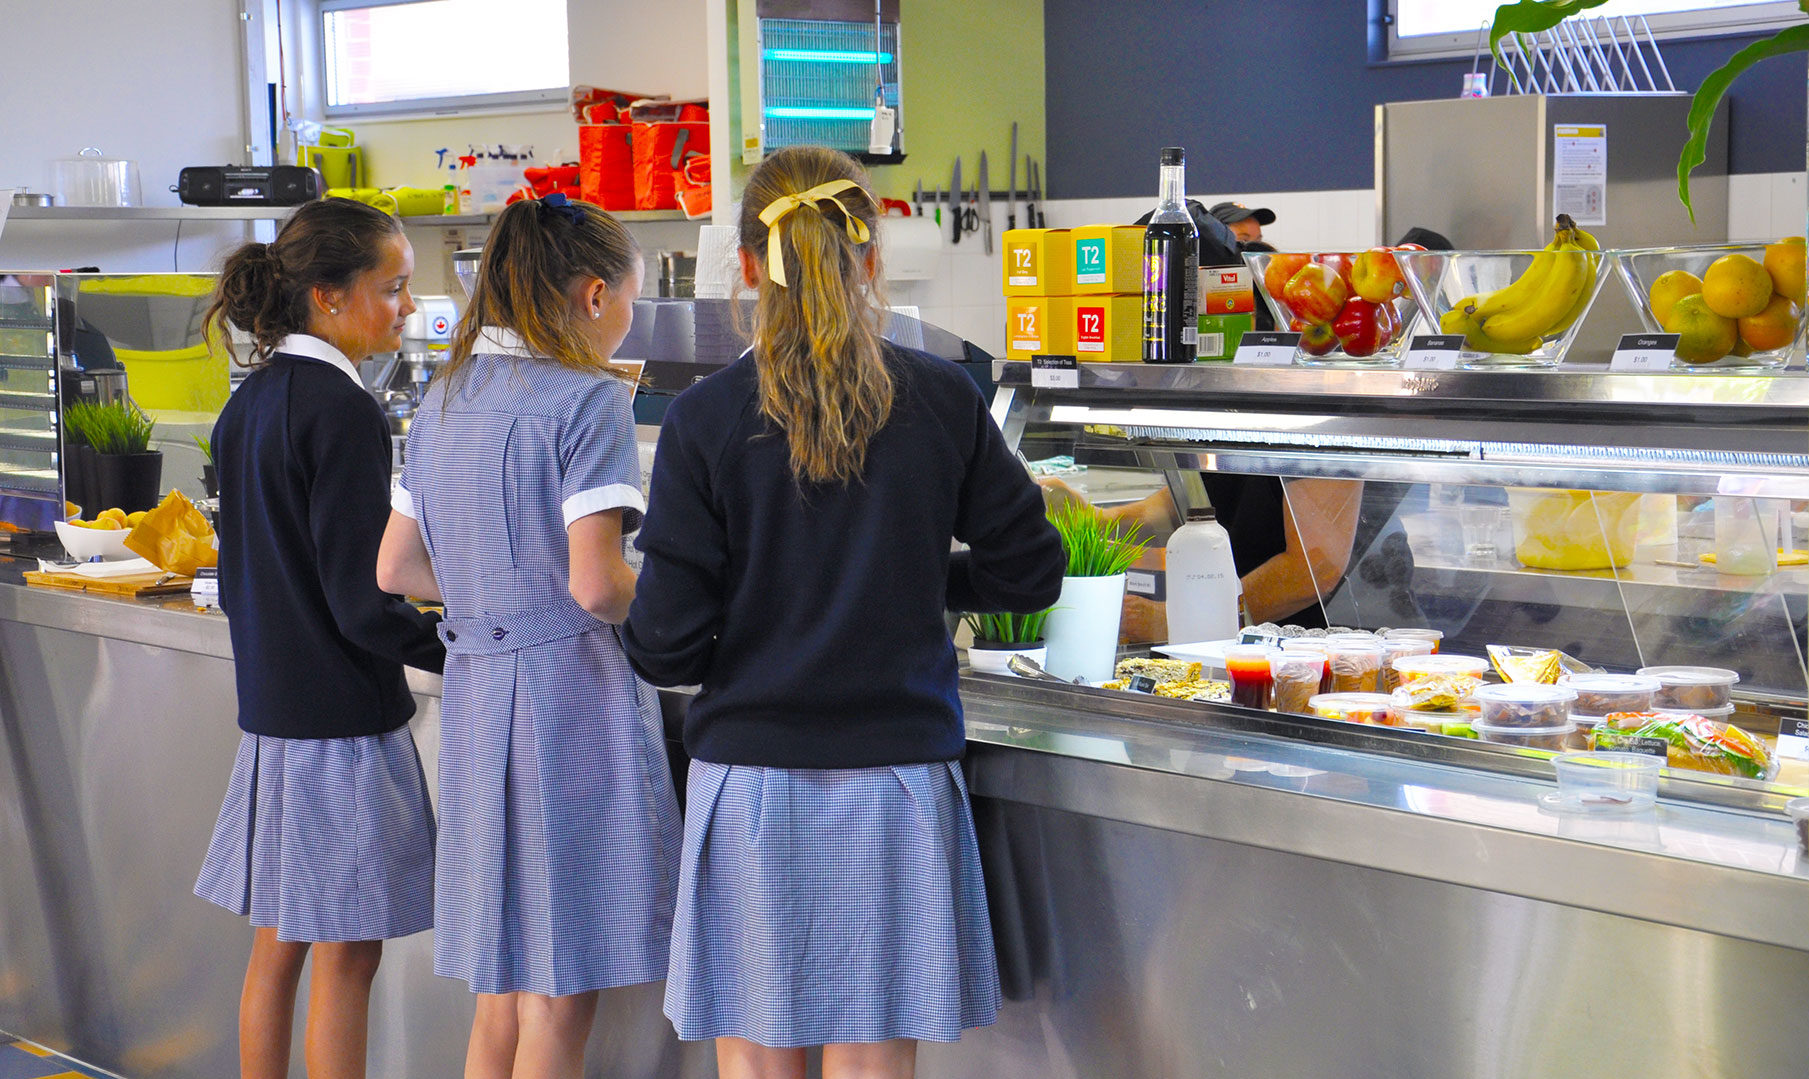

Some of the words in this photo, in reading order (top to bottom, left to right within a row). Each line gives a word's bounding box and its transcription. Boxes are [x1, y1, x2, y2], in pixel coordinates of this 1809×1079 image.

[1013, 249, 1031, 267] T2
[1081, 246, 1099, 264] T2
[1017, 313, 1035, 332] T2
[1082, 314, 1099, 332] T2
